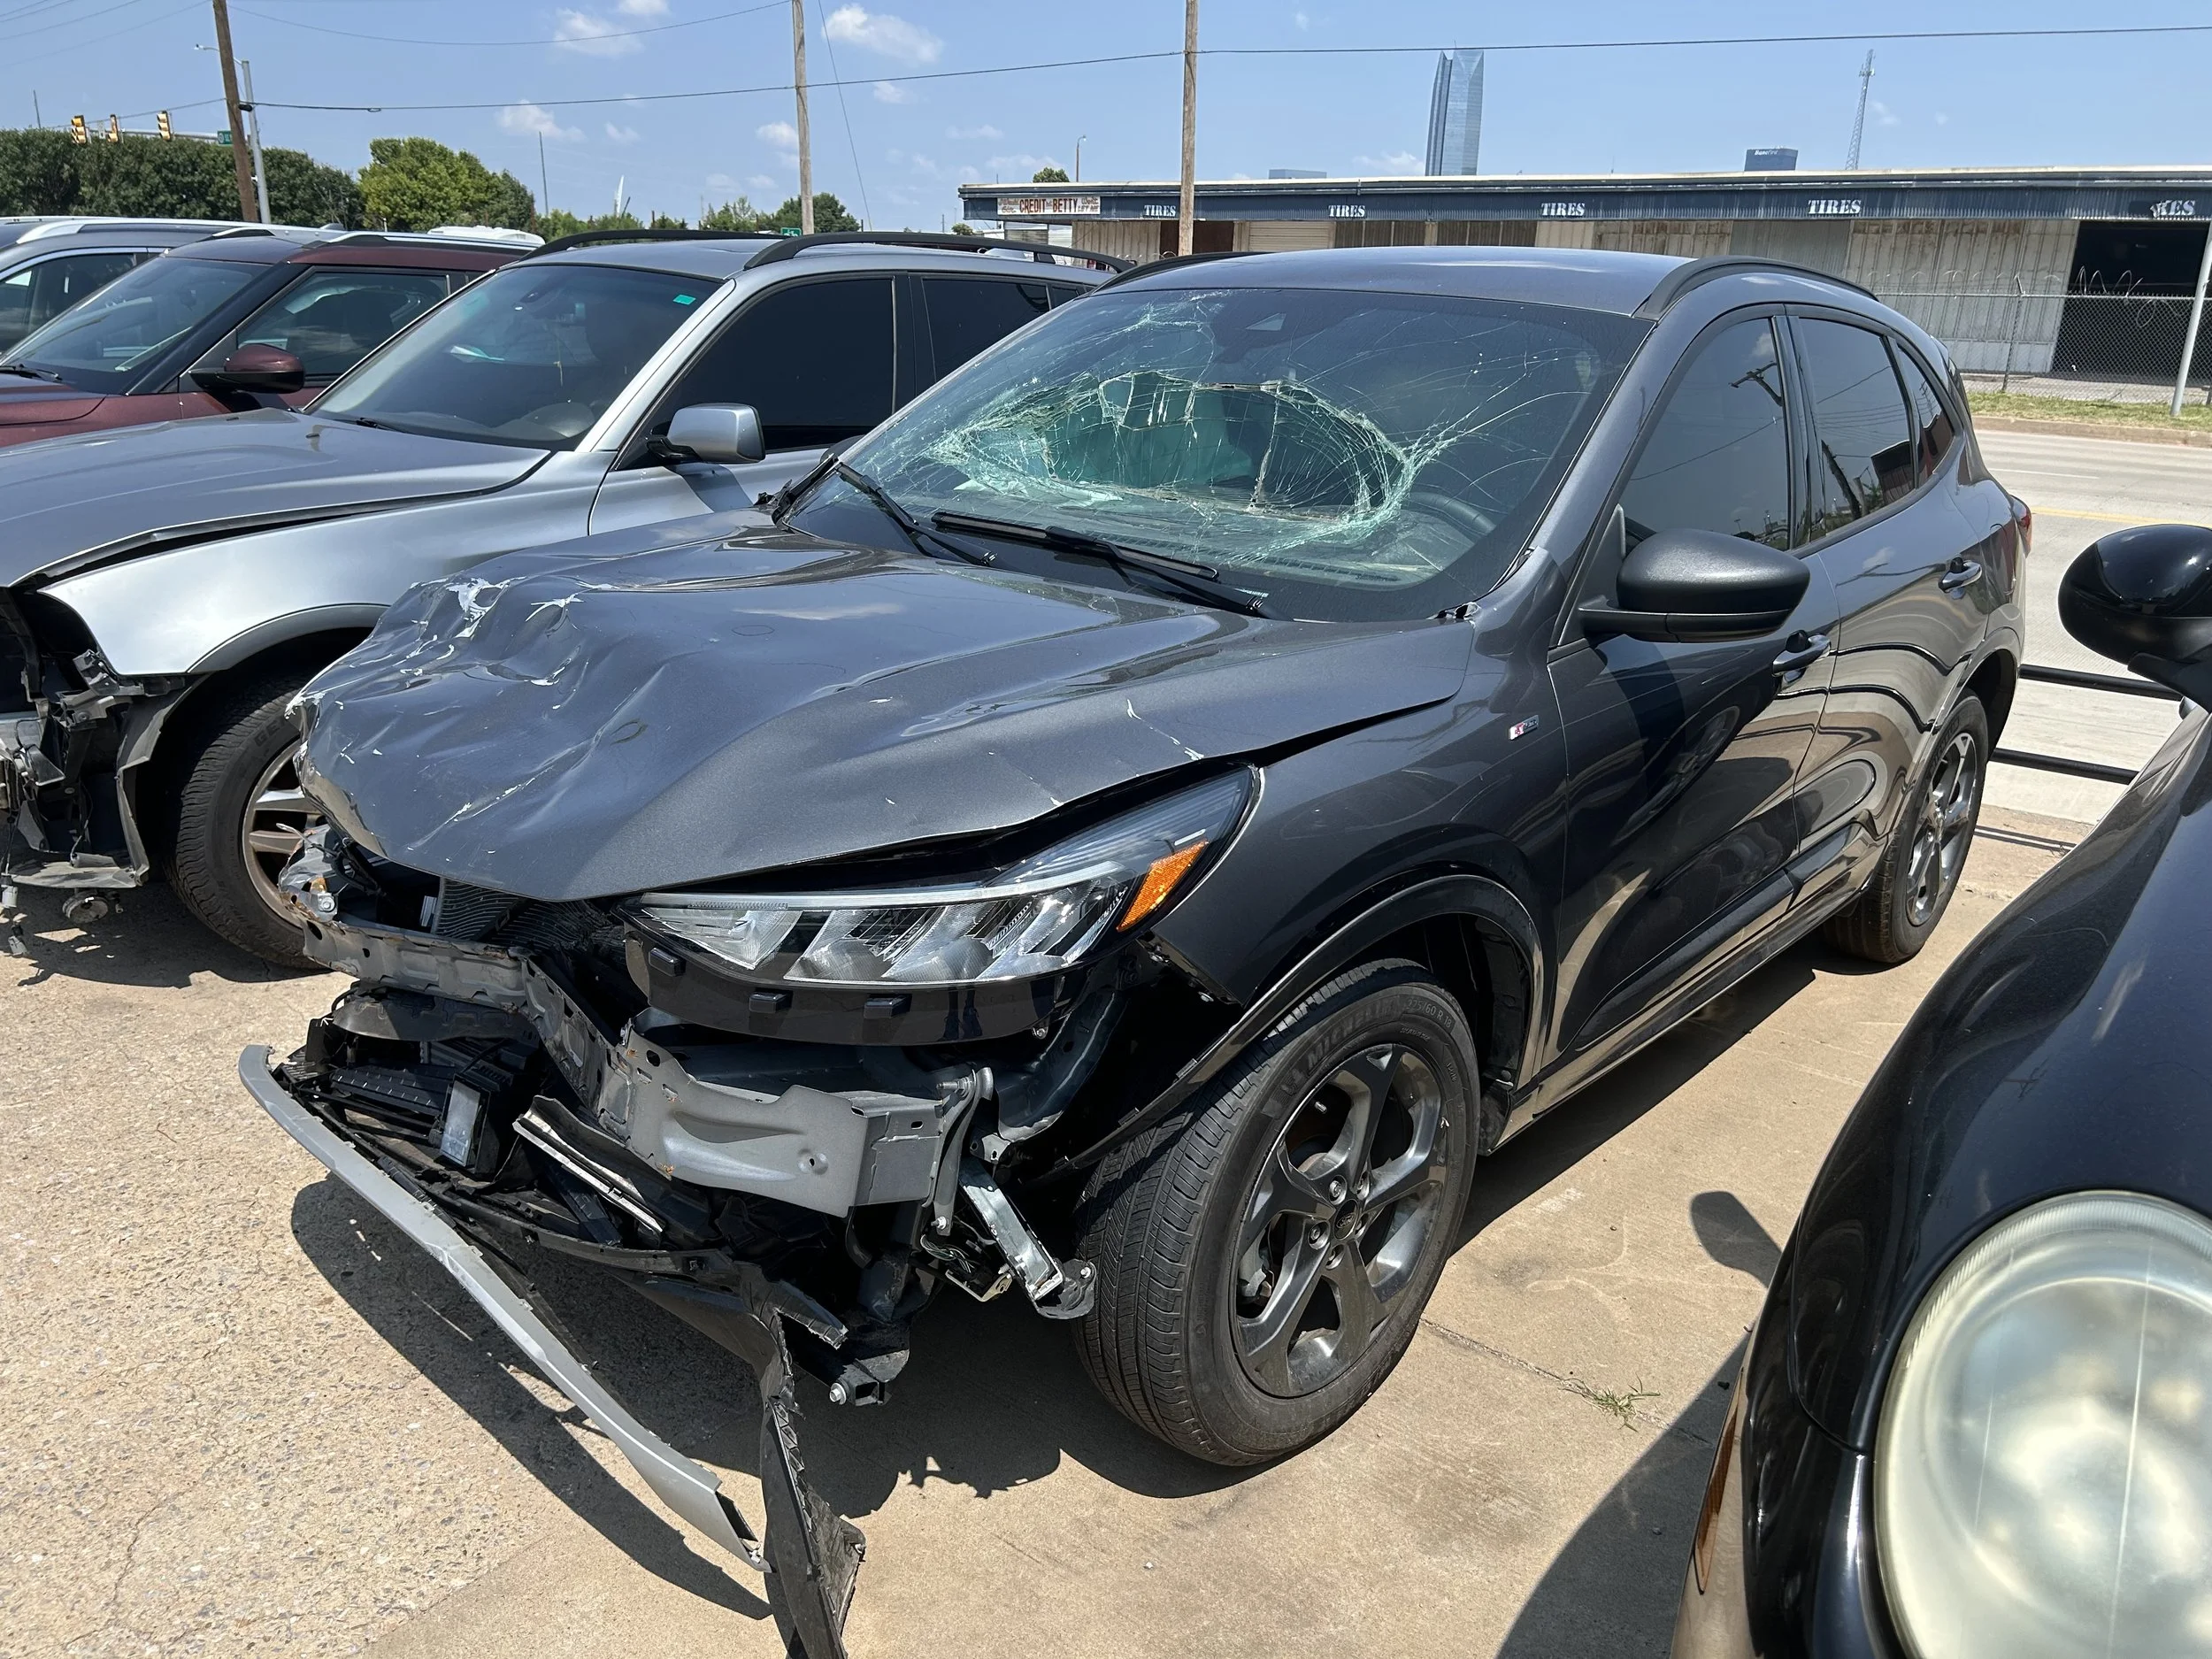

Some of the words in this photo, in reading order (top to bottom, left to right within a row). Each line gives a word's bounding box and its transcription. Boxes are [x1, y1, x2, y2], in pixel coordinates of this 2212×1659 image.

[1019, 198, 1046, 213] CREDIT
[1053, 198, 1078, 213] BETTY
[1144, 204, 1176, 217] TIRES
[1328, 204, 1365, 218] TIRES
[1540, 203, 1585, 216] TIRES
[1808, 199, 1862, 214] TIRES
[1437, 1010, 1444, 1020] R
[1444, 1016, 1453, 1028] 18
